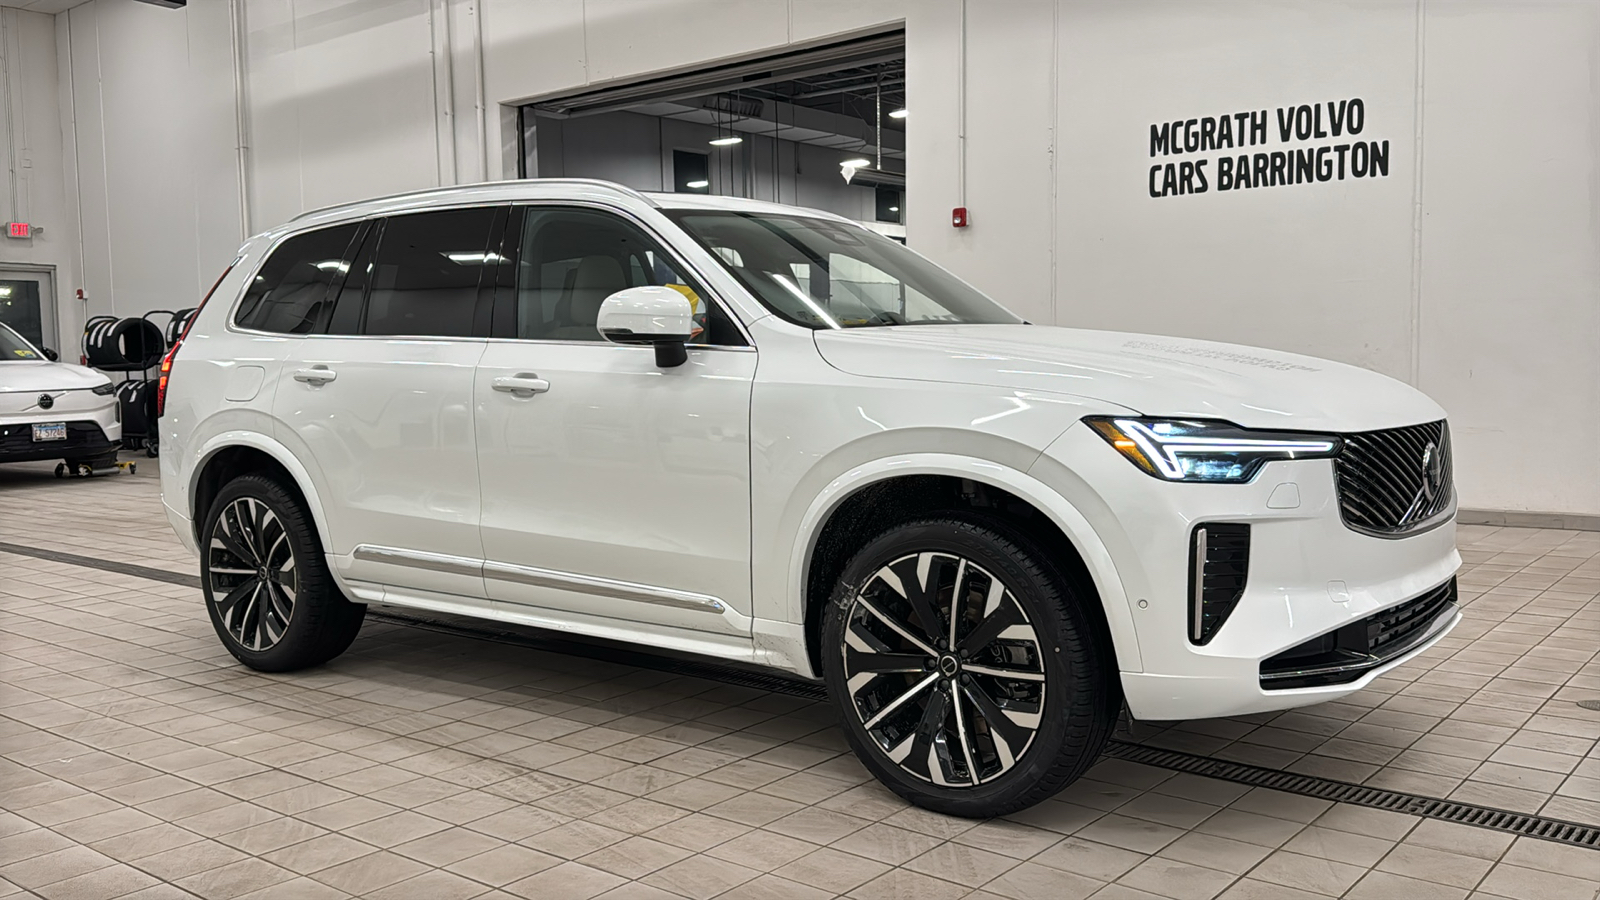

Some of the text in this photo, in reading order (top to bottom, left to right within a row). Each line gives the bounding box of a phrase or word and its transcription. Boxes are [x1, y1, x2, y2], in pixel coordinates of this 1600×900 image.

[1150, 98, 1364, 157] MCGRATH VOLVO
[1149, 140, 1389, 197] CARS BARRINGTON
[11, 223, 28, 236] EXIT
